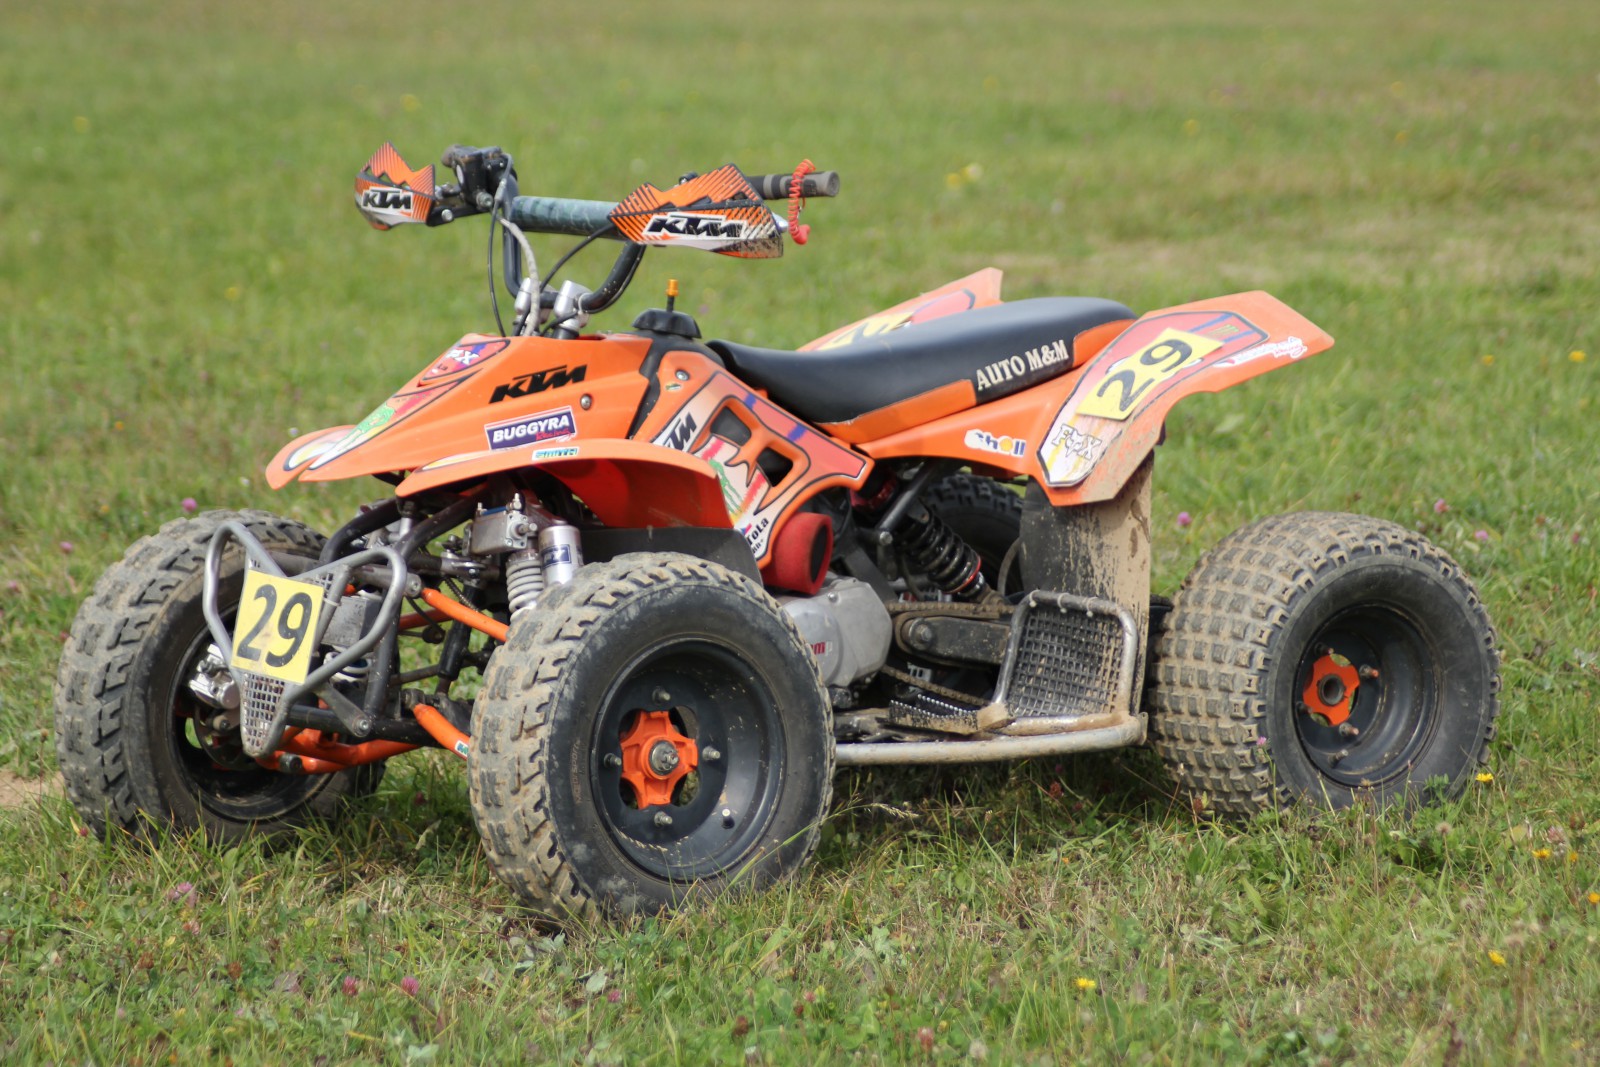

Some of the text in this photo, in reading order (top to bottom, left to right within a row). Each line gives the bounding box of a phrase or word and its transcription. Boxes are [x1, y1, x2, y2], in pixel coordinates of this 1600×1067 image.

[361, 188, 413, 211] KTM
[647, 214, 746, 240] KTM
[489, 364, 588, 404] KTM
[976, 339, 1070, 391] AUTO M&M
[1096, 338, 1194, 412] 29
[492, 414, 570, 443] BUGGYRA
[662, 412, 697, 450] TM
[236, 584, 314, 668] 29
